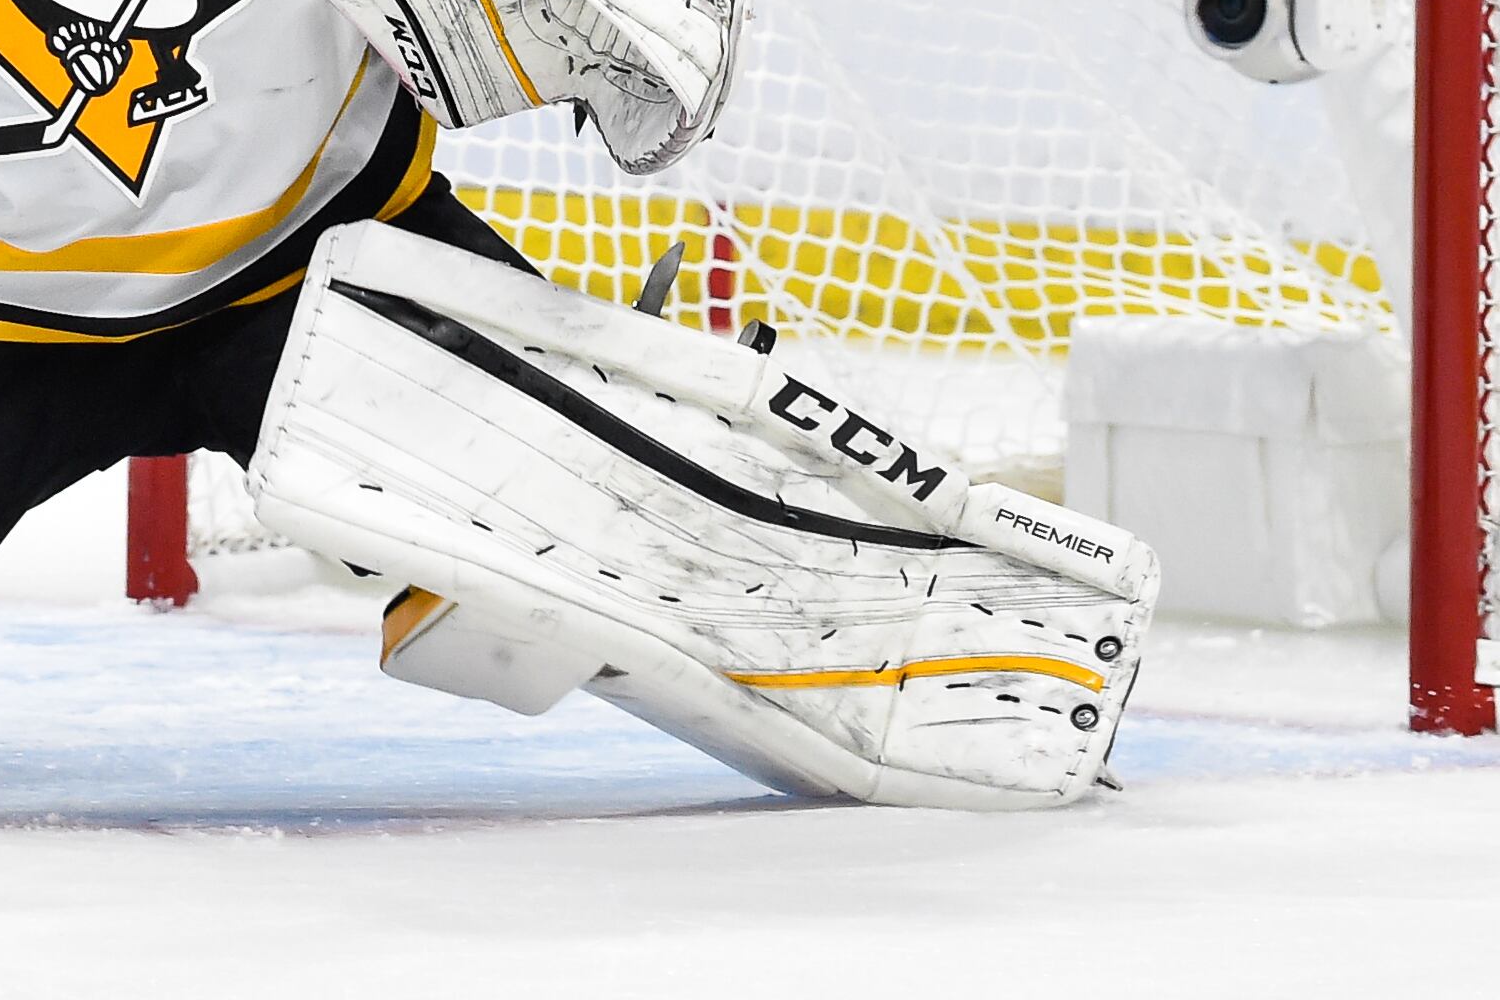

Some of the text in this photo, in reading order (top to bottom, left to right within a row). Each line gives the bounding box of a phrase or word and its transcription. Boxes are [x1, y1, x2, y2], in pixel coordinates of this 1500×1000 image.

[384, 14, 438, 101] CCM
[767, 372, 949, 503] CCM
[994, 507, 1116, 565] PREMIER
